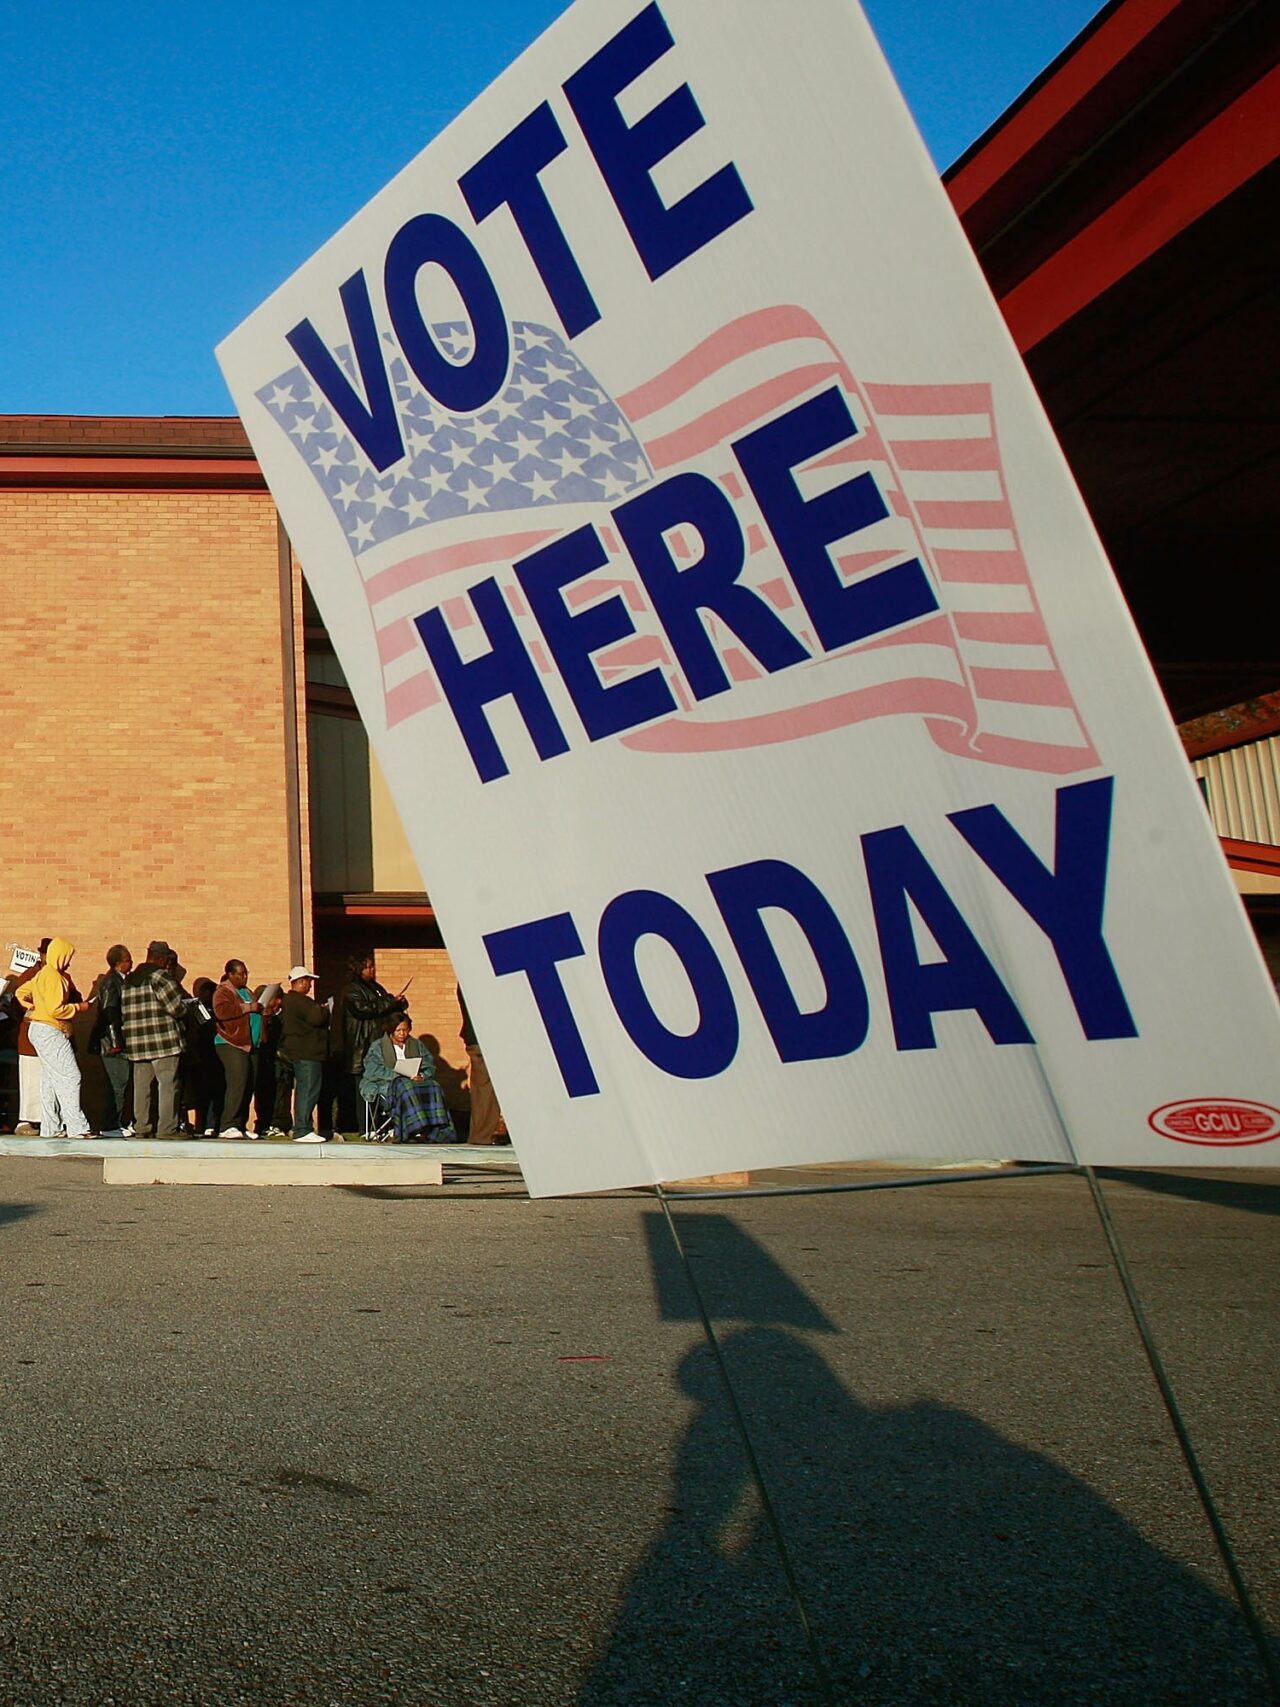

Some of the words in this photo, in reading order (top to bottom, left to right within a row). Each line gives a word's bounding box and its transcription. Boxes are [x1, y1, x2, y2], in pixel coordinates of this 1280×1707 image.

[287, 1, 753, 472] VOTE
[414, 386, 940, 783] HERE
[483, 776, 1139, 1098] TODAY
[1195, 1113, 1241, 1131] GCIU
